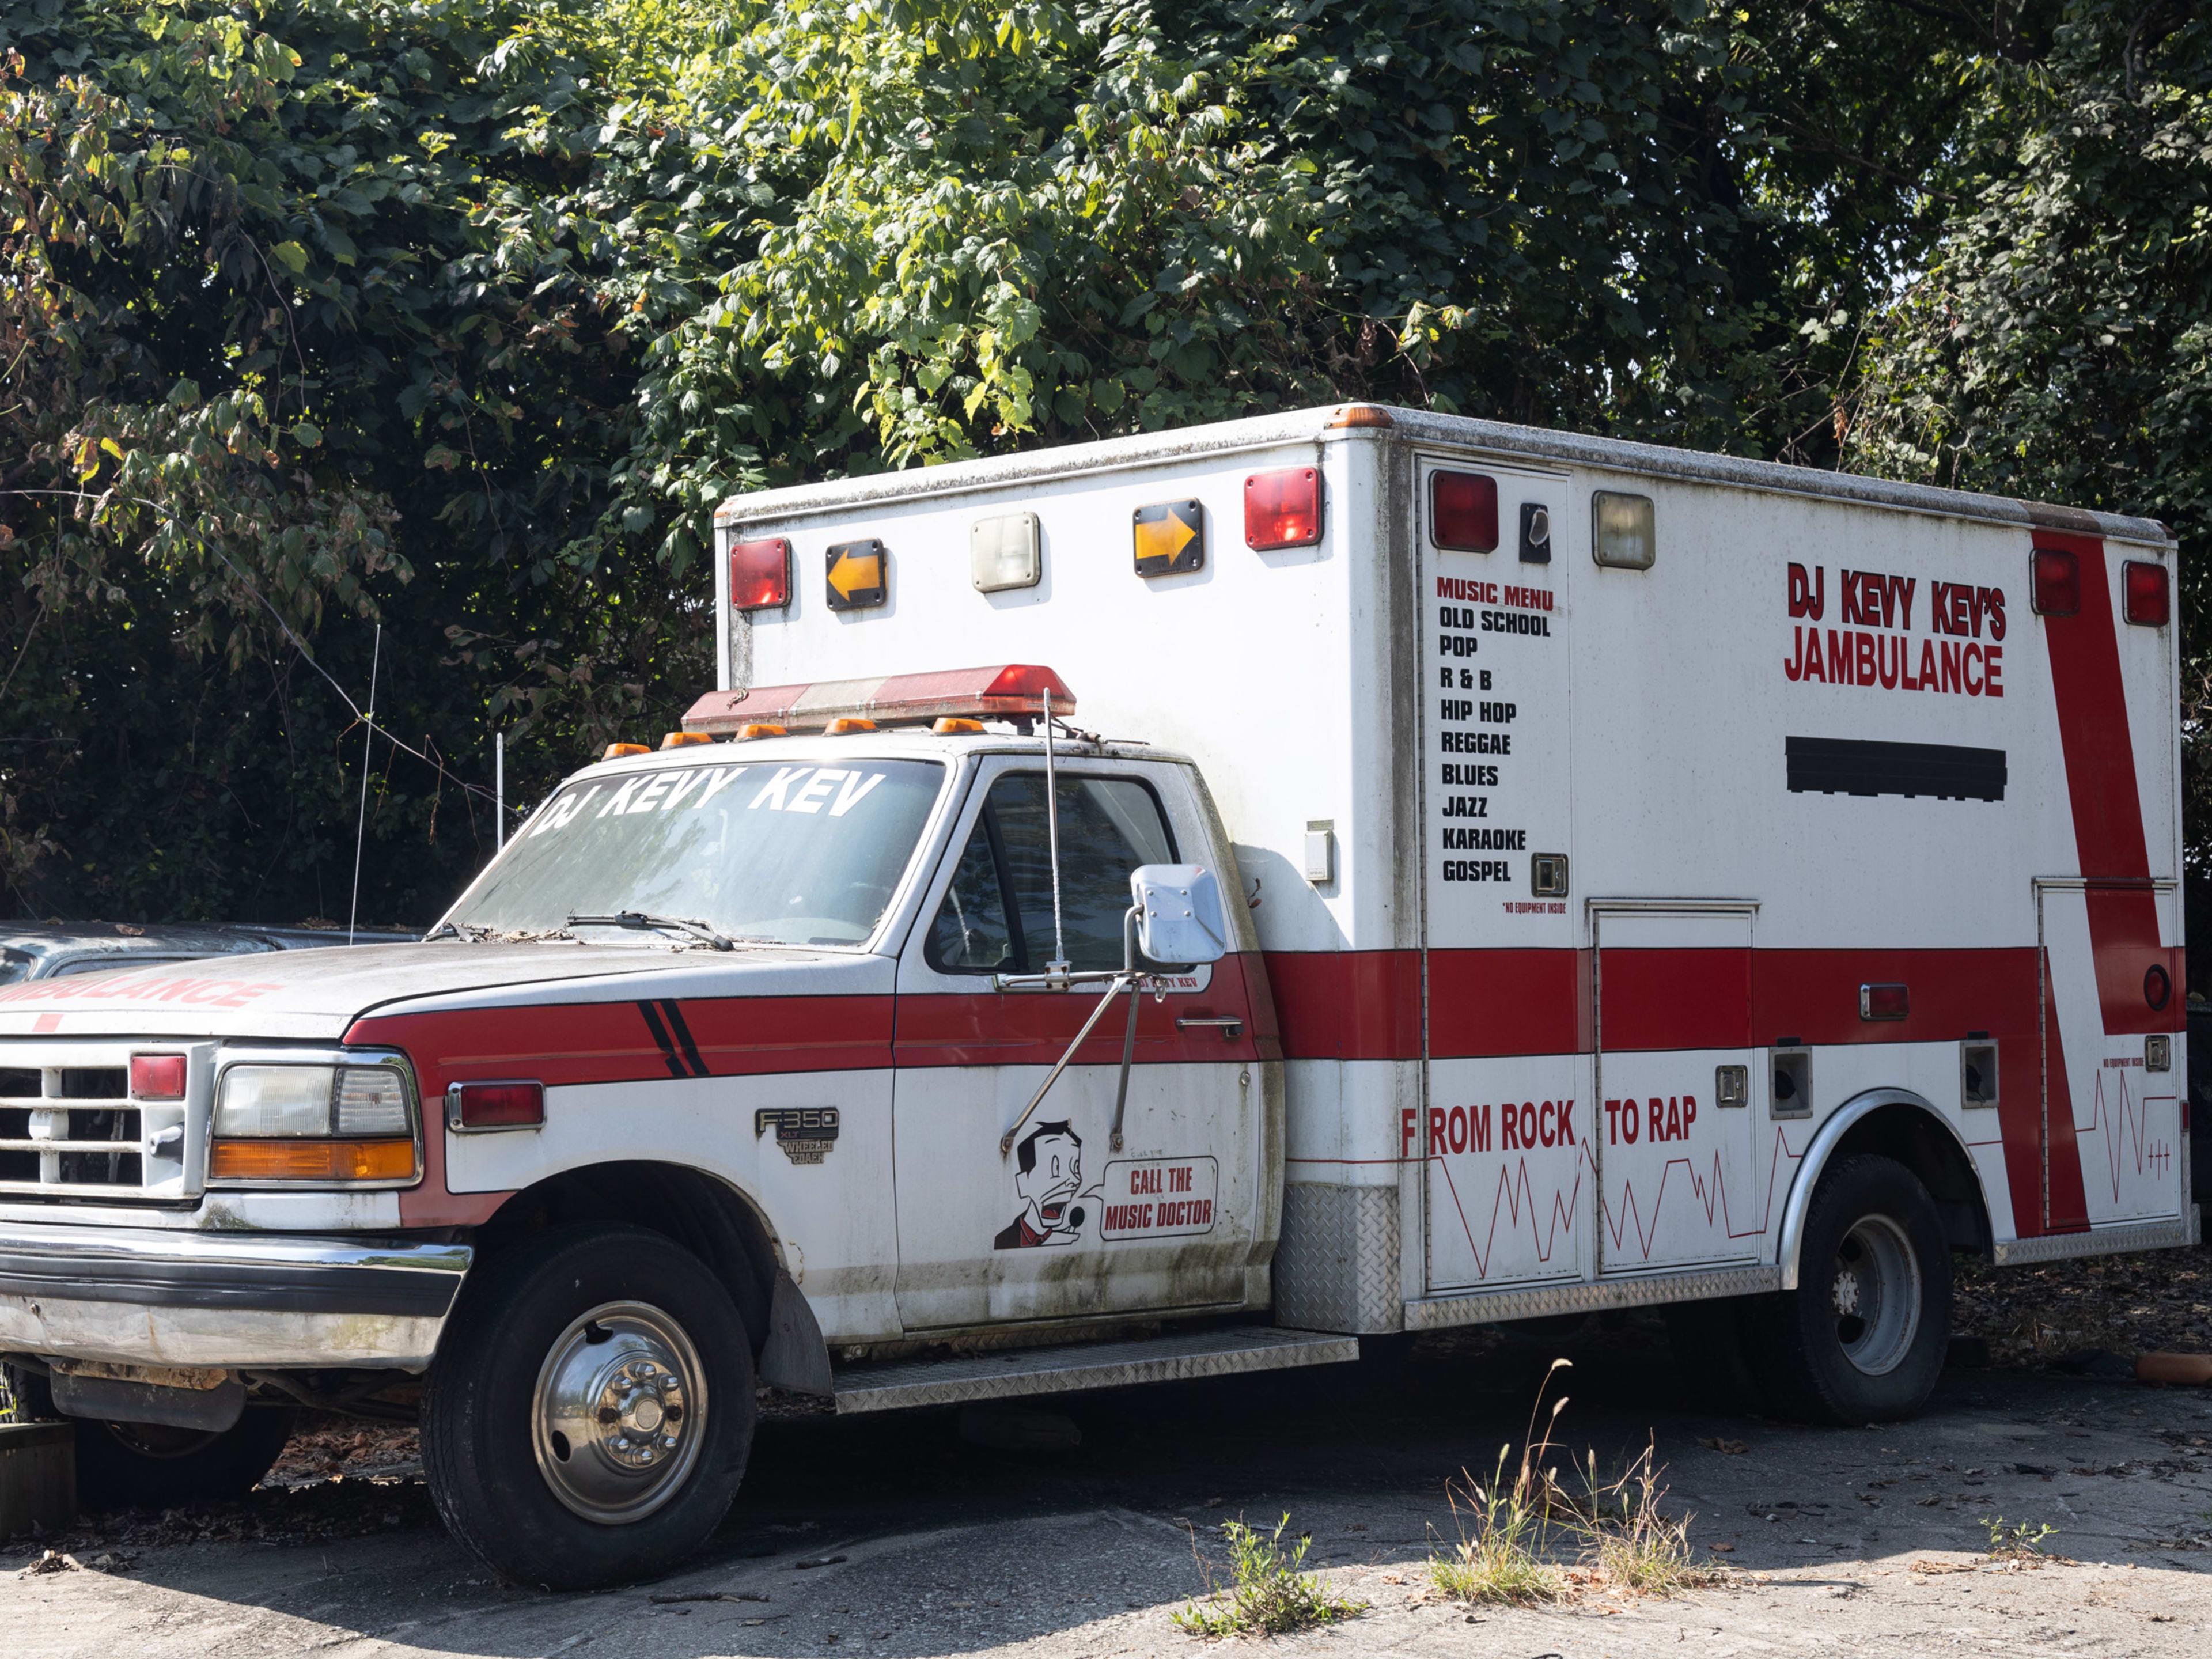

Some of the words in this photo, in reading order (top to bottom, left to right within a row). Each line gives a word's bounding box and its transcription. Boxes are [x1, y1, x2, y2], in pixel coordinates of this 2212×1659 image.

[1437, 576, 1498, 604] MUSIC
[1504, 585, 1554, 611] MENU
[1787, 561, 1824, 622] DJ
[1841, 569, 1916, 630] KEVY
[1931, 580, 2006, 642] KEV'S
[1440, 606, 1474, 630] OLD
[1480, 610, 1551, 637] SCHOOL
[1440, 634, 1478, 657] POP
[1784, 626, 2004, 698] JAMBULANCE
[1440, 666, 1453, 688] R
[1460, 668, 1474, 690] &
[1479, 669, 1492, 691] B
[1441, 699, 1473, 721] HIP
[1479, 701, 1517, 724] HOP
[1441, 731, 1511, 755] REGGAE
[1442, 763, 1499, 786] BLUES
[528, 784, 602, 839] DJ
[596, 767, 749, 819] KEVY
[747, 767, 887, 817] KEV
[1442, 796, 1488, 817] JAZZ
[1442, 828, 1526, 851] KARAOKE
[1442, 860, 1512, 882] GOSPEL
[1515, 902, 1546, 915] EQUIPMENT
[1548, 903, 1566, 914] INSIDE
[0, 976, 286, 1008] MBULANCE
[1177, 976, 1198, 988] KEV
[1402, 1104, 1491, 1157] FROM
[1501, 1099, 1575, 1151] ROCK
[1605, 1097, 1639, 1145] TO
[1649, 1095, 1697, 1143] RAP
[782, 1140, 835, 1152] WHEELED
[1130, 1168, 1162, 1195] CALL
[1169, 1166, 1192, 1192] THE
[1104, 1203, 1153, 1230] MUSIC
[1156, 1199, 1212, 1227] DOCTOR
